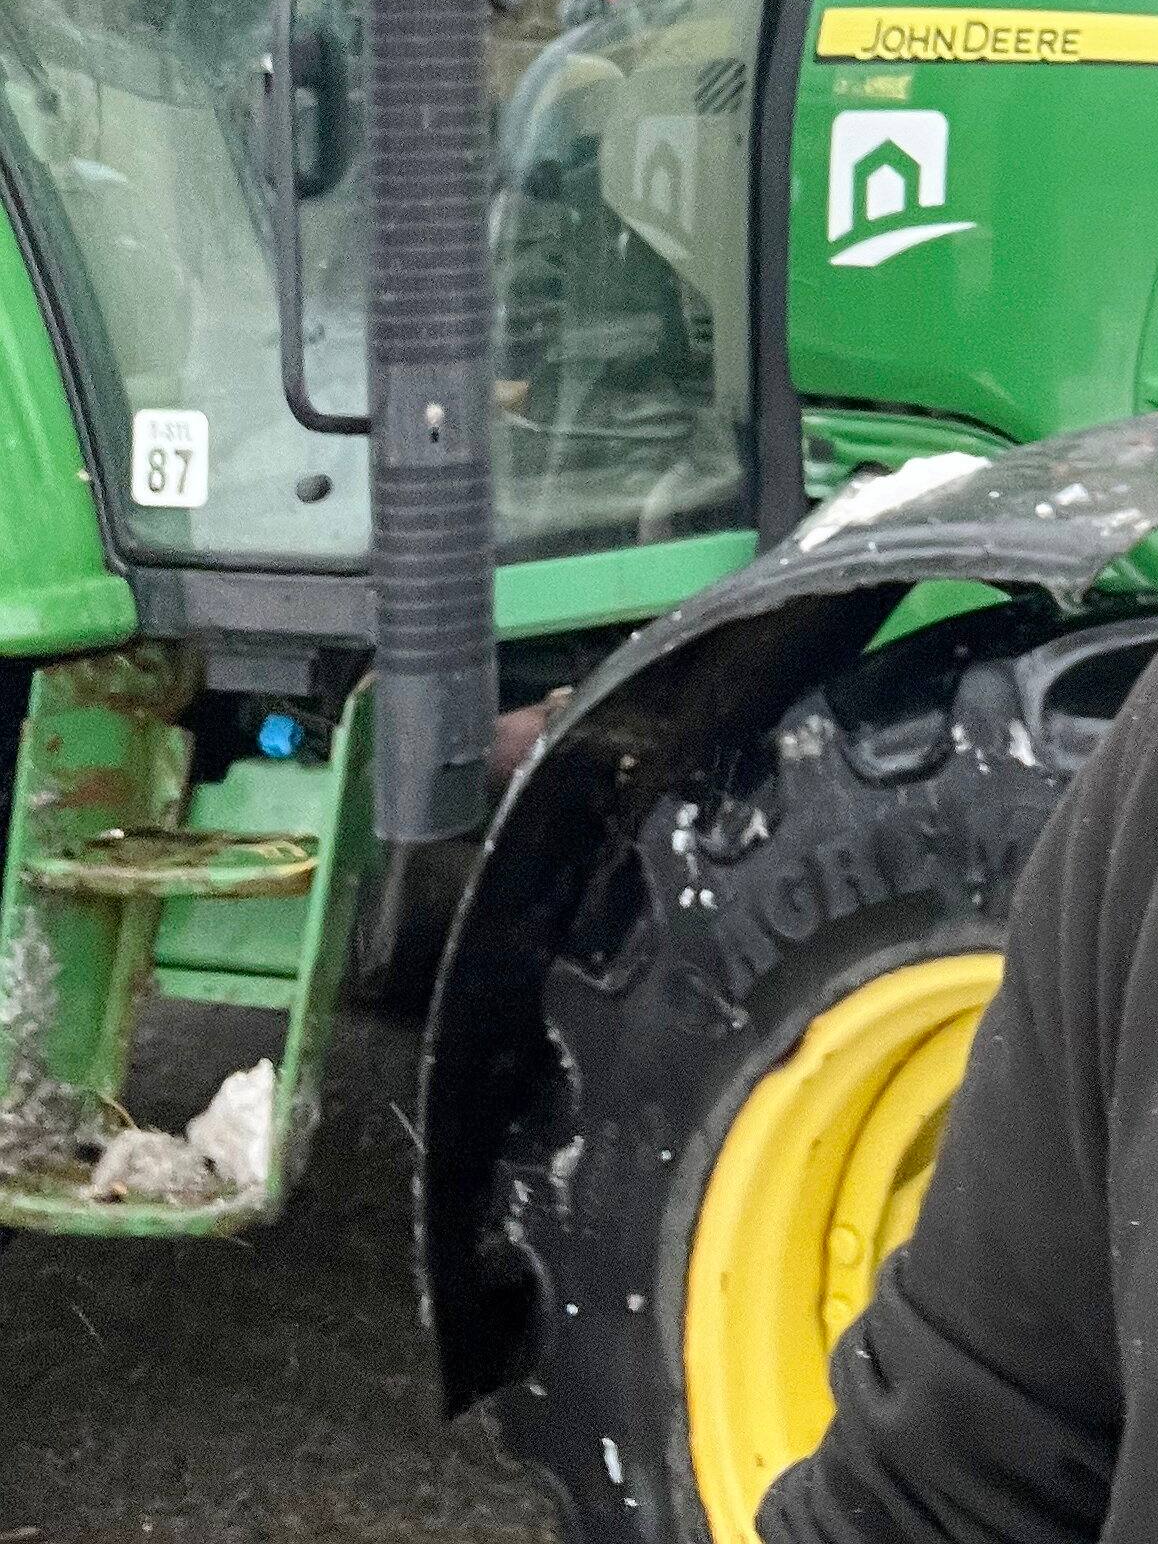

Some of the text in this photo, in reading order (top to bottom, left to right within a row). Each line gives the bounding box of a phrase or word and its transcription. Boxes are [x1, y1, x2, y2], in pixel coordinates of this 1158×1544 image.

[861, 16, 1082, 56] JOHN DEERE
[147, 446, 194, 495] 87
